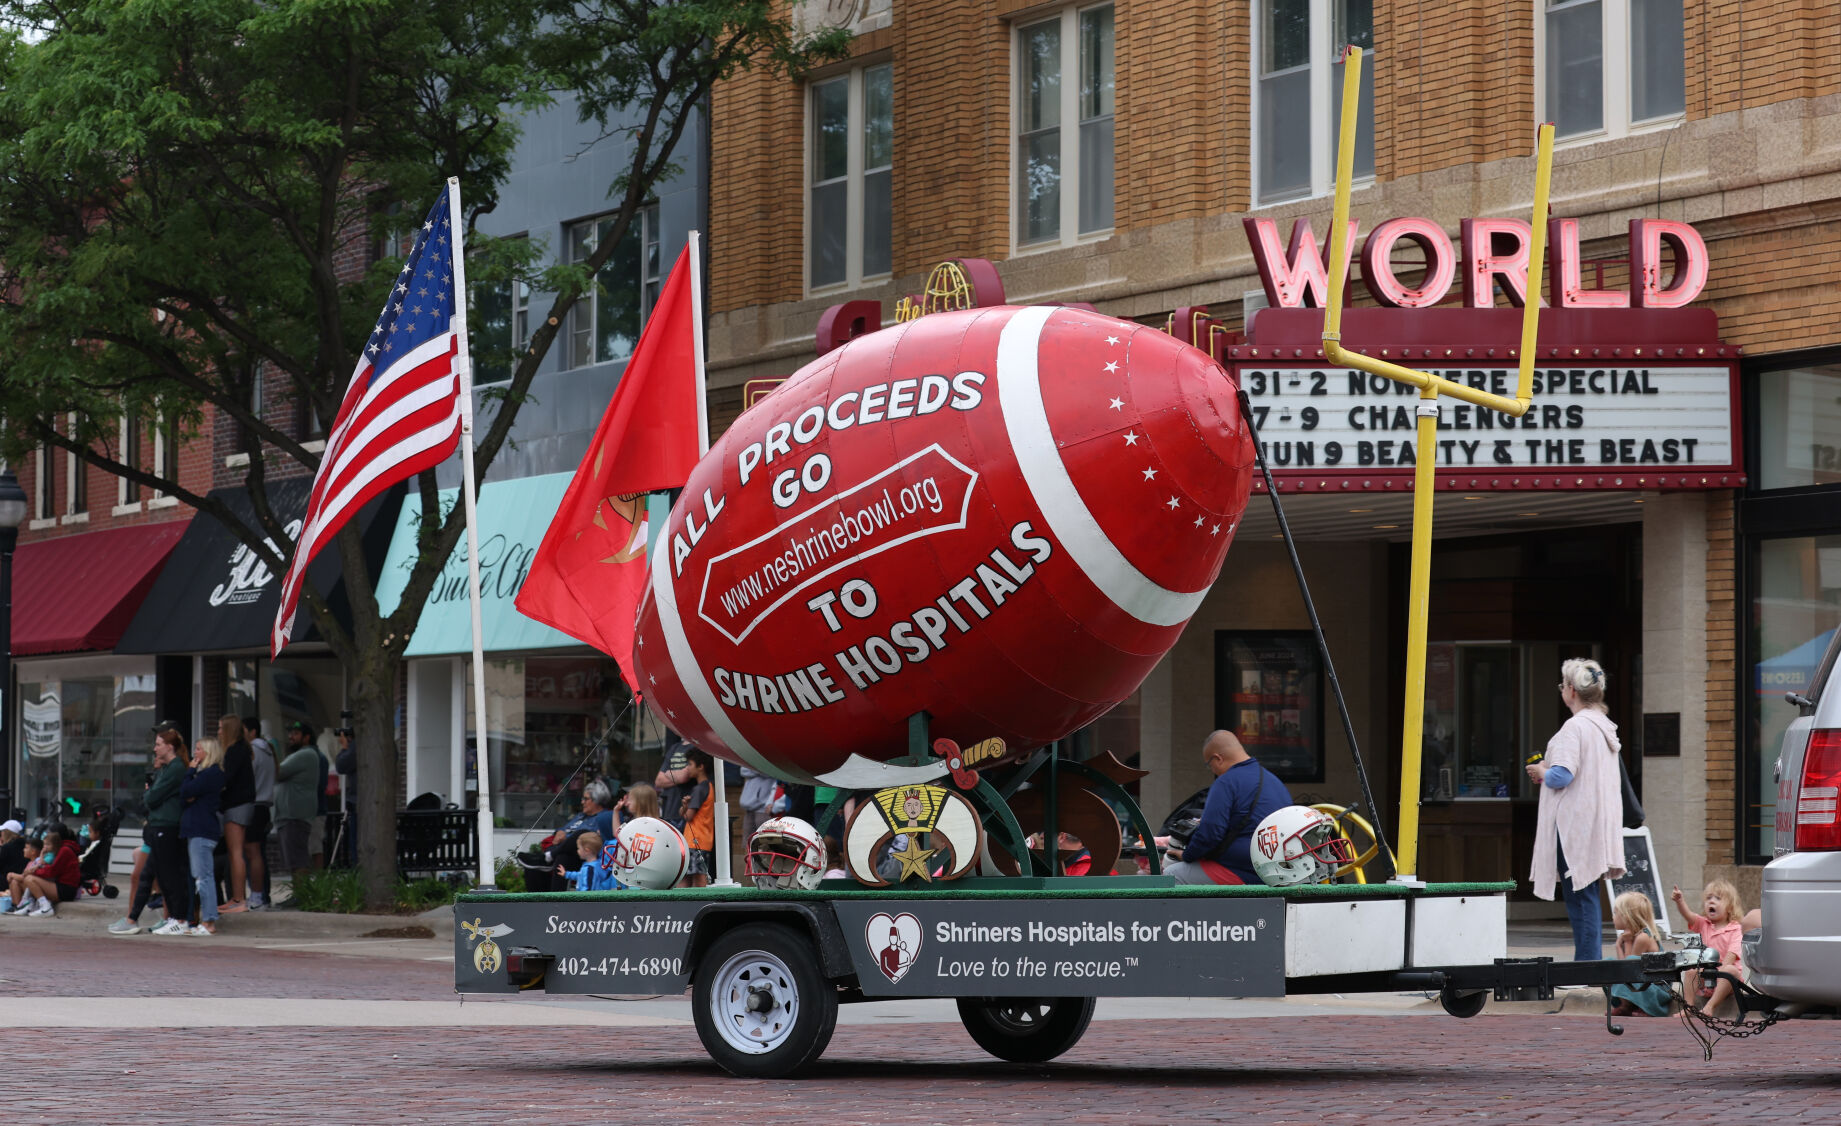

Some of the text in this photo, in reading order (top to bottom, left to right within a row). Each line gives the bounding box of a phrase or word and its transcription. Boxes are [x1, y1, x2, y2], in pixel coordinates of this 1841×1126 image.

[1242, 216, 1709, 309] WORLD
[1348, 371, 1507, 395] NOWERE
[1532, 370, 1658, 394] SPECIAL
[1348, 405, 1584, 430] CHALENGERS
[1324, 441, 1343, 466] 9
[1357, 440, 1480, 466] BEATY
[1493, 440, 1513, 465] &
[1525, 439, 1585, 464] THE
[1600, 438, 1698, 463] BEAST
[670, 371, 986, 578] ALL PROCEEDS
[771, 452, 833, 509] GO
[720, 474, 943, 619] www.neshrinebowl.org
[713, 520, 1053, 715] SHRINE HOSPITALS
[807, 578, 878, 633] TO
[545, 914, 694, 935] Sesostris Shrine
[936, 921, 1023, 943] Shriners
[1028, 921, 1126, 947] Hospitals
[1131, 921, 1162, 943] for
[557, 956, 682, 977] 402-474-6890
[937, 957, 985, 978] Love
[990, 959, 1012, 978] to
[1016, 957, 1048, 978] the
